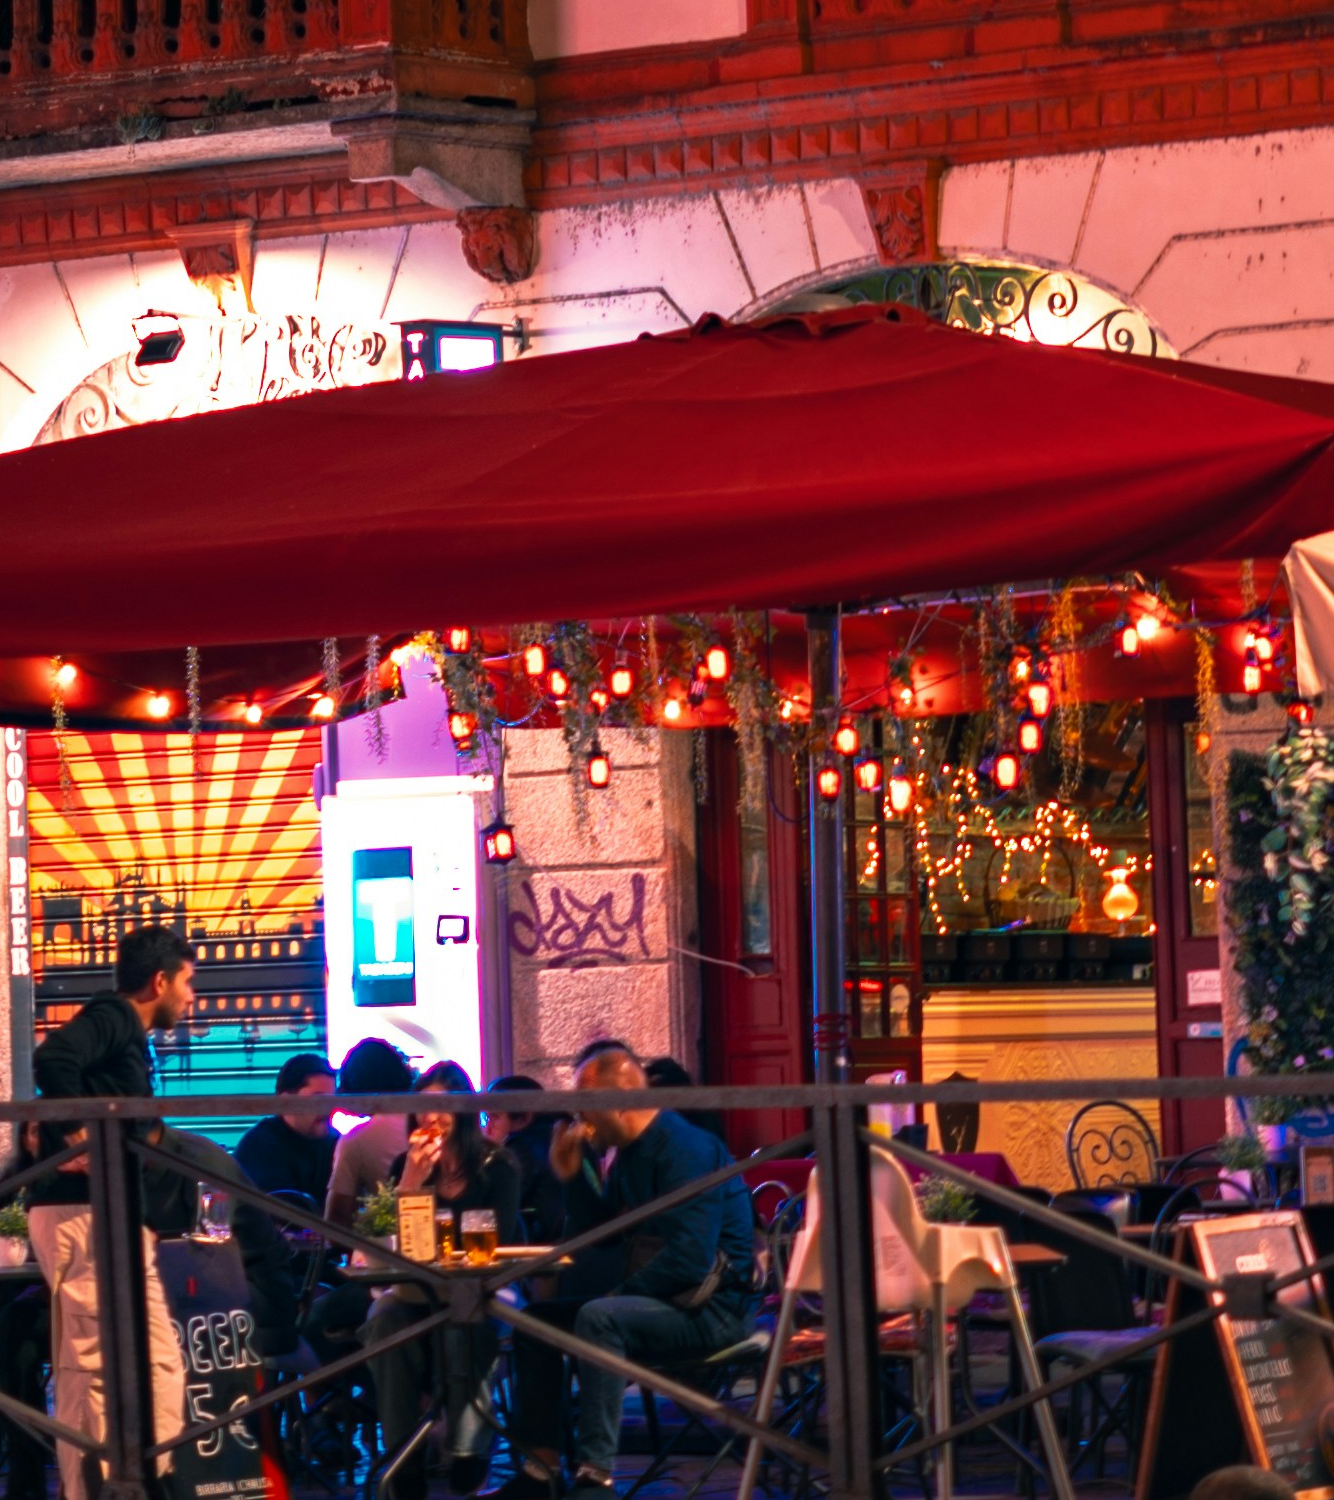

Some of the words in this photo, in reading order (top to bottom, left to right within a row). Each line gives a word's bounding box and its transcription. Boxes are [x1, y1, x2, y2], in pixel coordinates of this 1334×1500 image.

[5, 727, 25, 837] COOL
[8, 856, 30, 976] BEER
[170, 1309, 262, 1374] BEER
